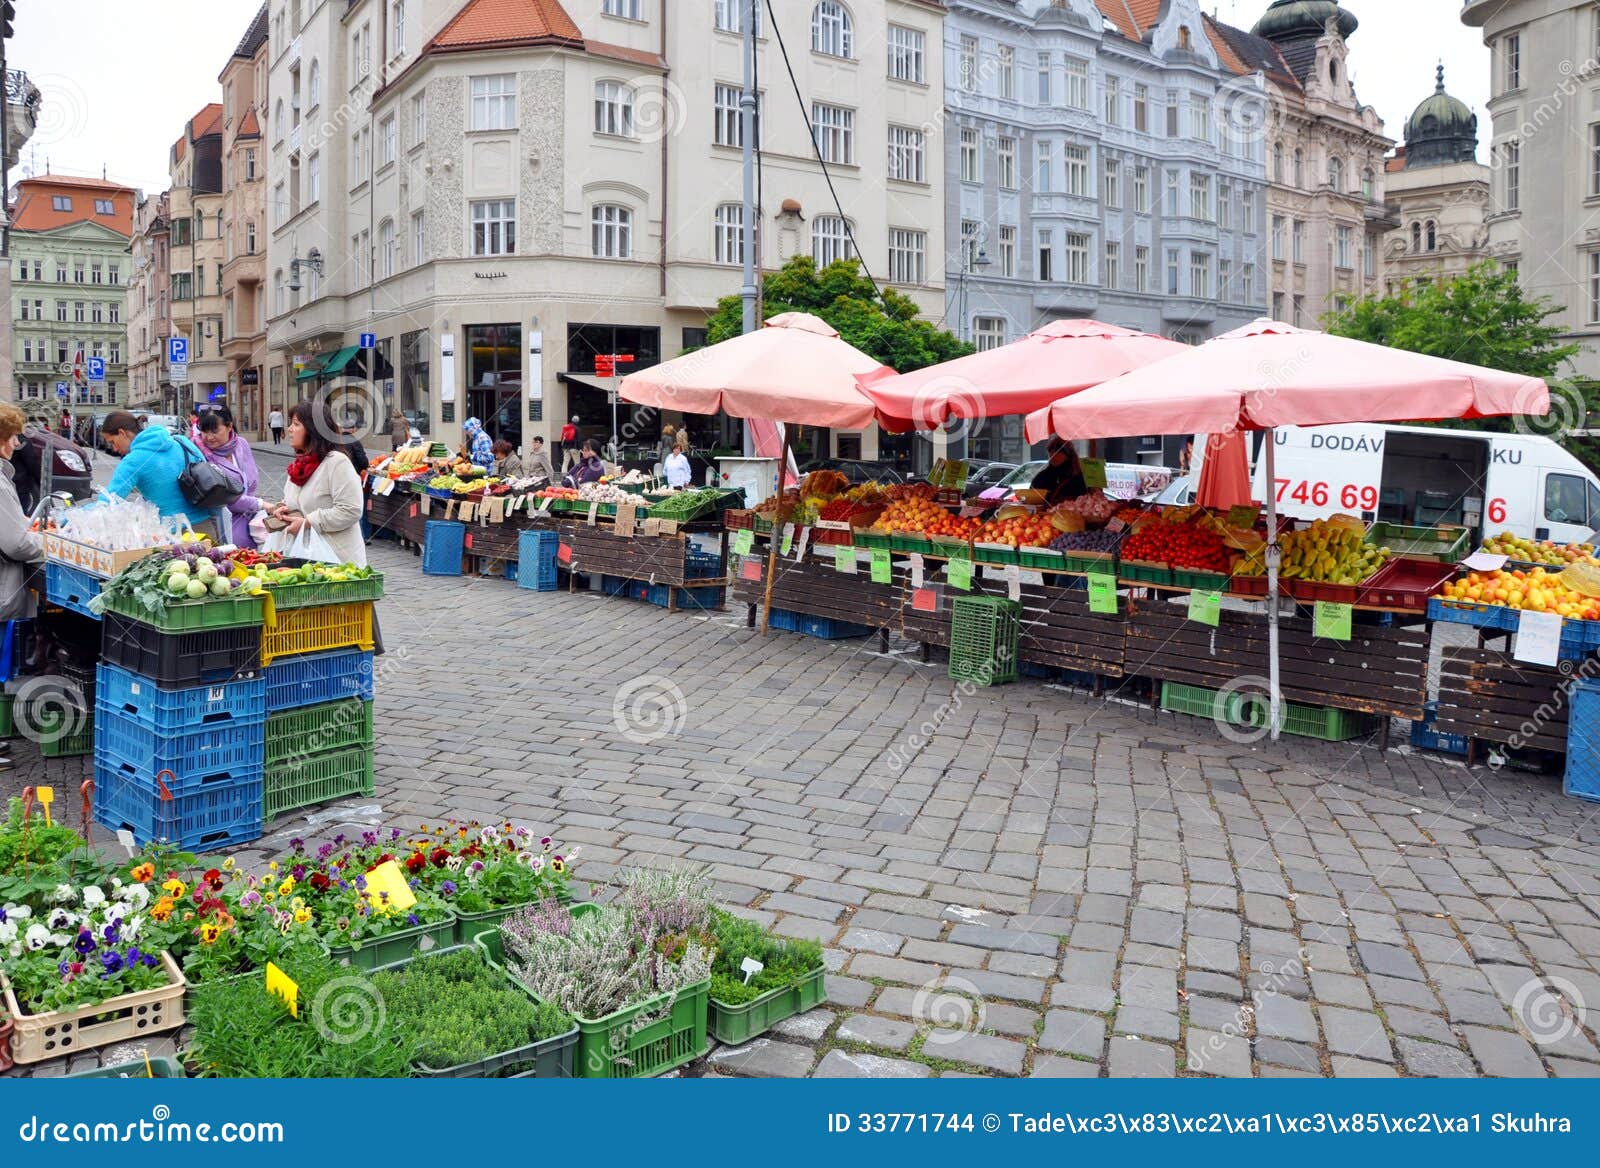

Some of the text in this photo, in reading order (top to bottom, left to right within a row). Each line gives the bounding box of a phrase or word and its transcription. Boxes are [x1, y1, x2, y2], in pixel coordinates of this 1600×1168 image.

[1274, 478, 1506, 523] 746 69 6
